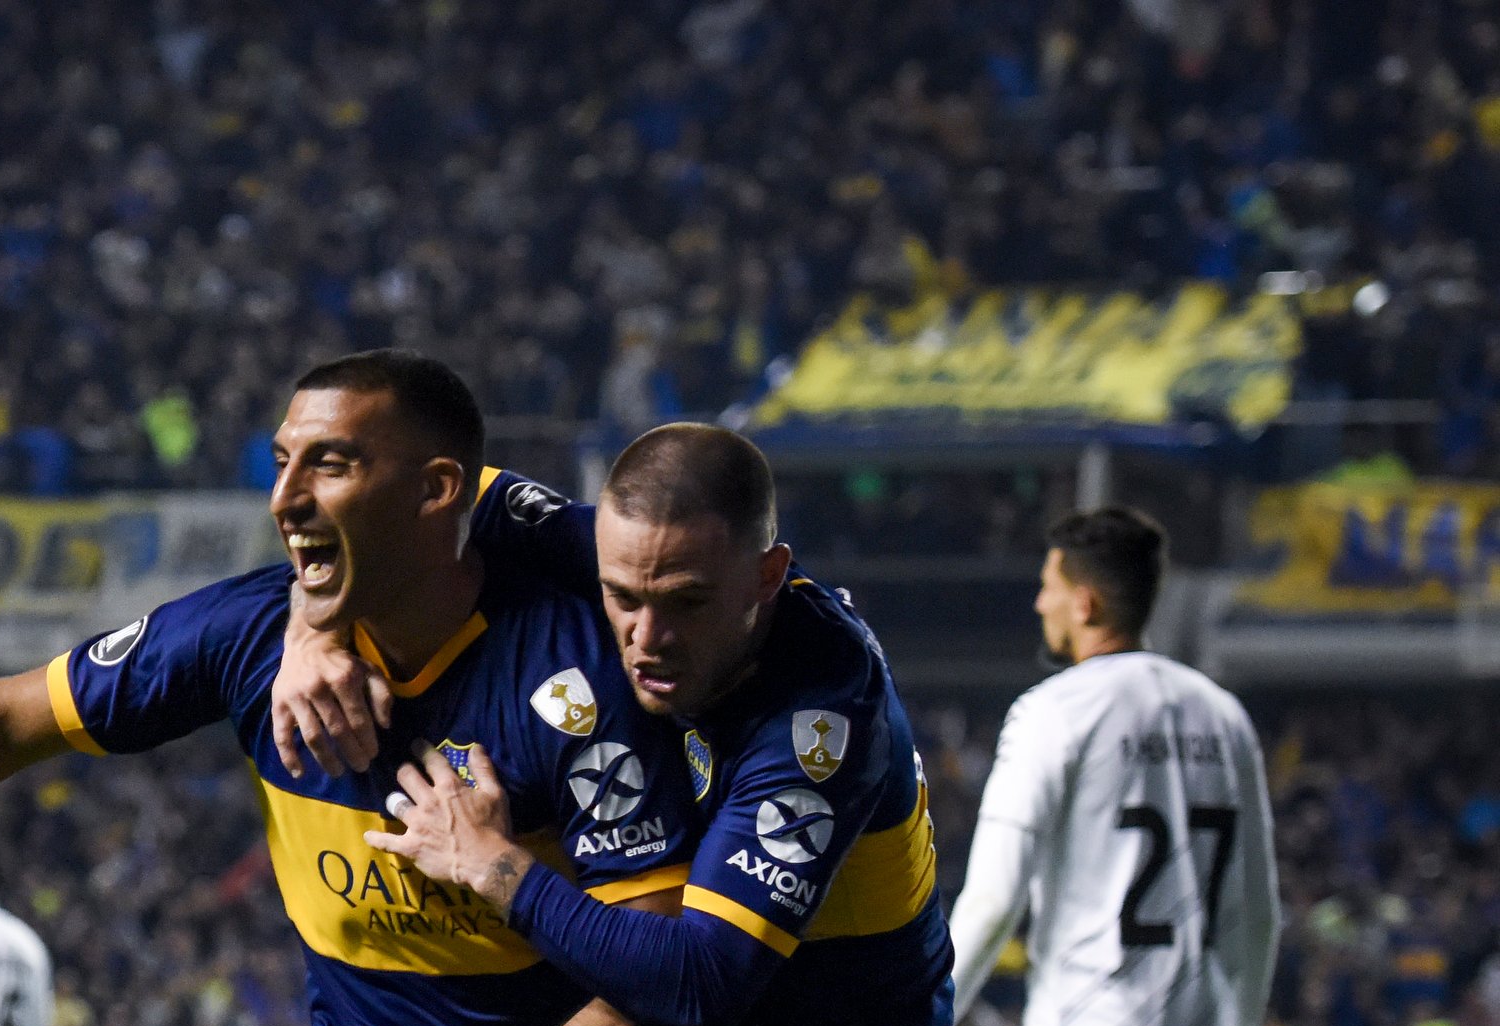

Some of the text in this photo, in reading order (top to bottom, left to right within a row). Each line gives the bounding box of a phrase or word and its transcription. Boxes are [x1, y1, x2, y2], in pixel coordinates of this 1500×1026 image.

[569, 706, 582, 720] 6
[814, 749, 825, 764] 6
[573, 816, 665, 858] AXION
[624, 839, 667, 858] energy
[724, 848, 818, 906] AXION
[1115, 806, 1237, 947] 27
[769, 890, 809, 917] energy
[368, 908, 504, 937] AIRWAYS
